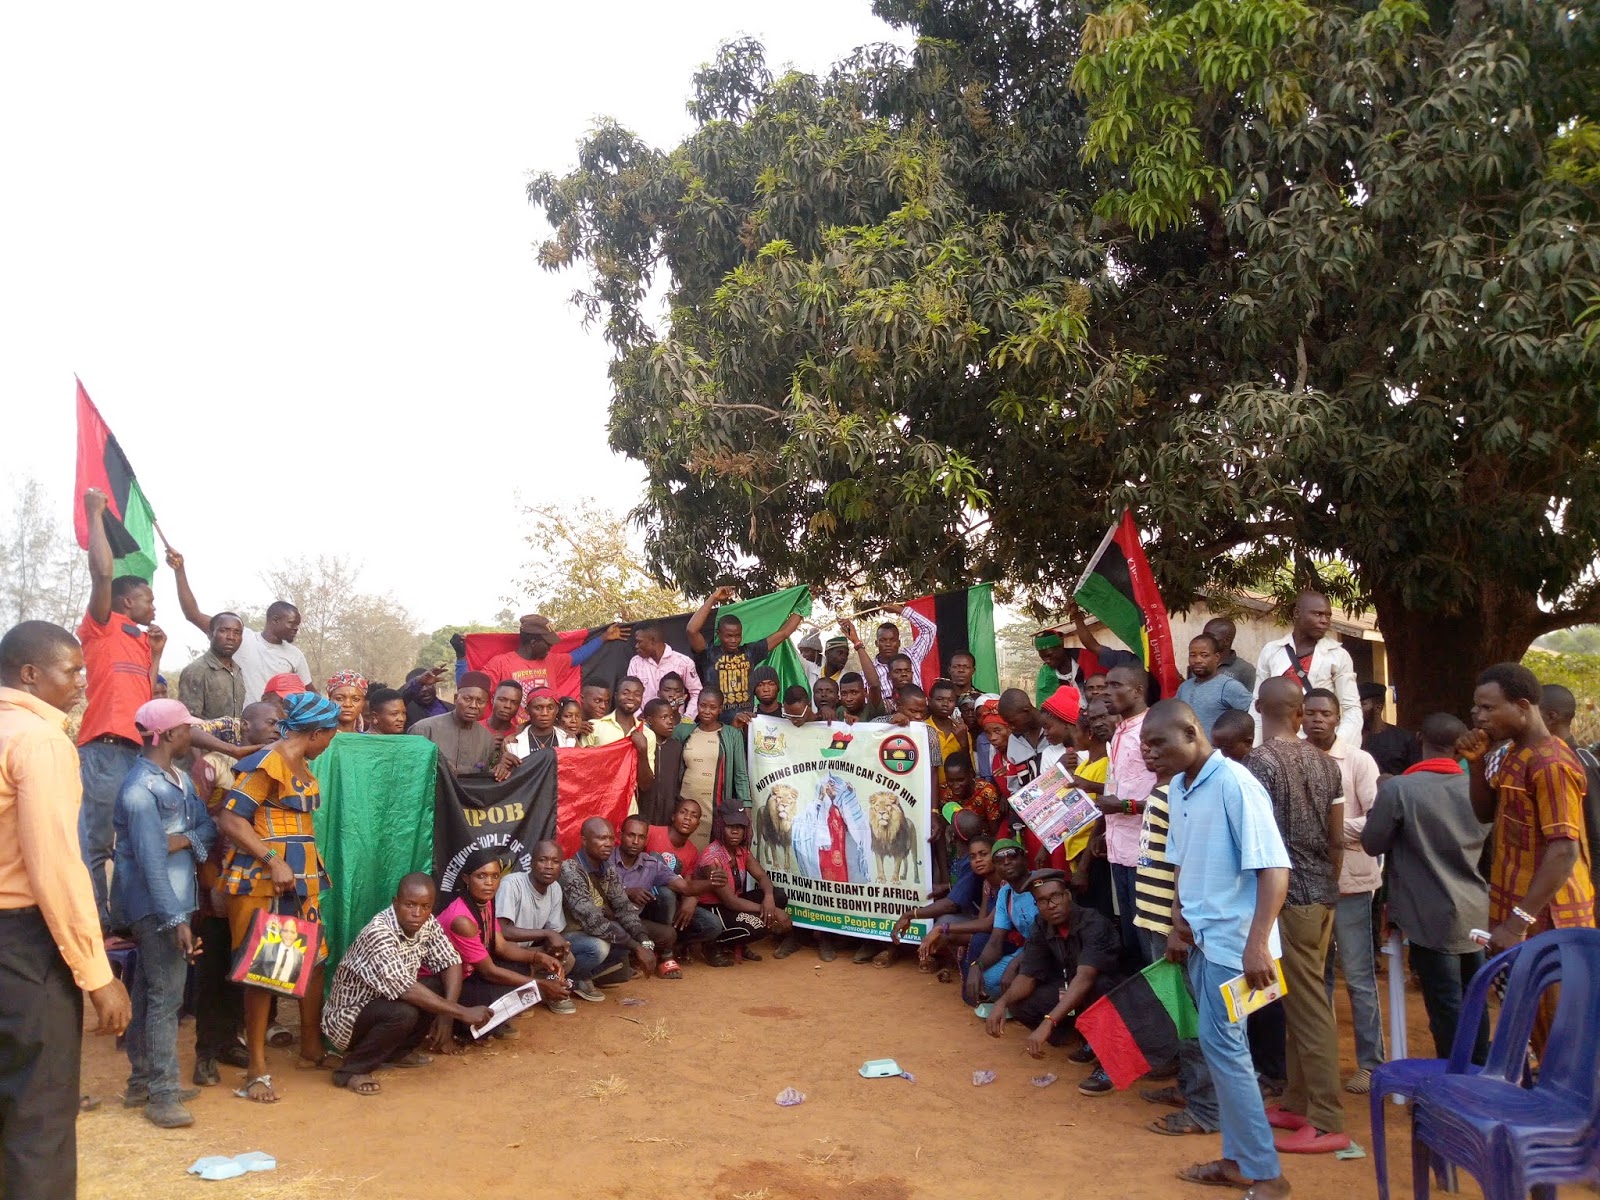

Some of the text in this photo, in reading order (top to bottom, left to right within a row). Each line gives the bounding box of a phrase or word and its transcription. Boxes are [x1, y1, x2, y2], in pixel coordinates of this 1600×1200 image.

[756, 760, 917, 808] NOTHING BORN OF WOMAN CAN STOP HIM
[463, 802, 525, 827] IPOB
[509, 839, 525, 853] OF
[766, 870, 791, 886] AFRA,
[792, 875, 813, 889] NOW
[814, 880, 833, 893] THE
[834, 883, 865, 897] GIANT
[867, 886, 880, 898] OF
[883, 887, 919, 902] AFRICA
[812, 893, 835, 908] ZONE
[837, 898, 872, 912] EBONYI
[795, 907, 842, 924] Indigenous
[844, 916, 877, 929] People
[879, 919, 891, 931] of
